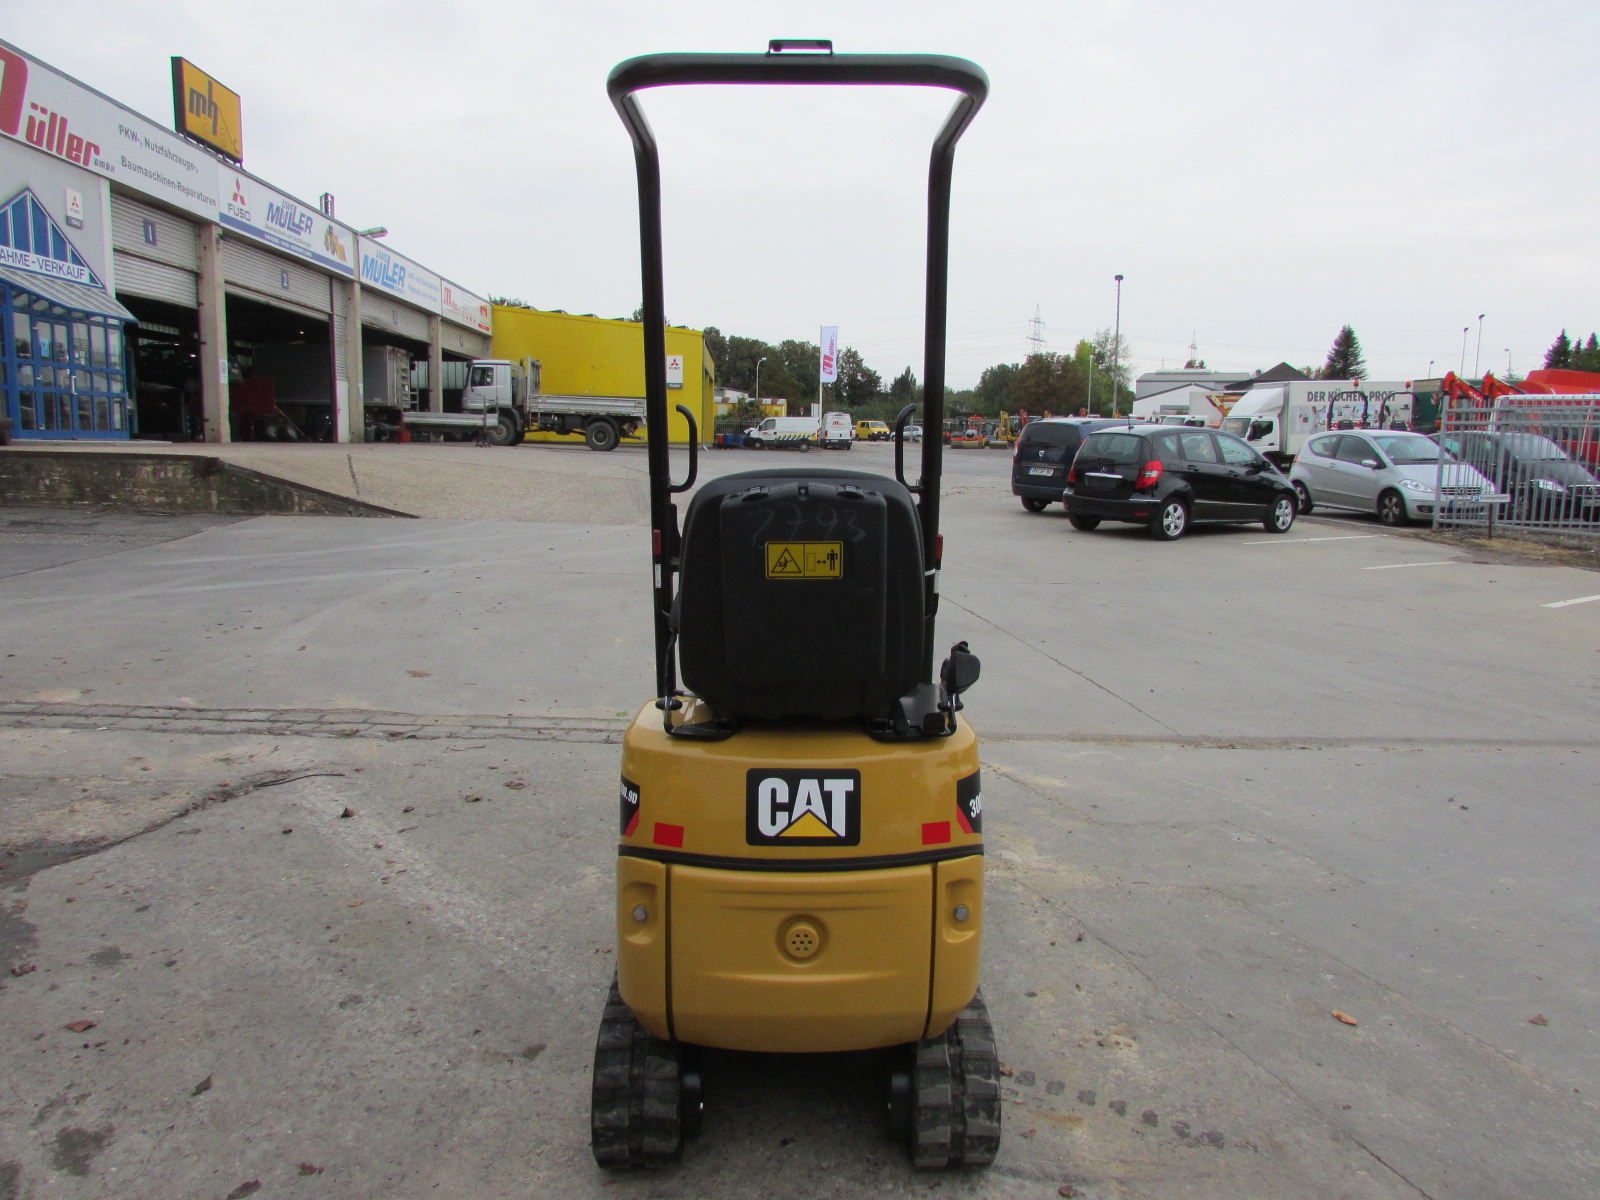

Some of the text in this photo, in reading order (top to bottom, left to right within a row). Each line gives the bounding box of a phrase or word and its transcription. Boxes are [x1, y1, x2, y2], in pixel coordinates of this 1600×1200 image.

[121, 155, 217, 207] Baumaschinen-Reparaturen
[227, 203, 251, 221] FUSO
[1307, 391, 1326, 402] DER
[757, 776, 854, 837] CAT
